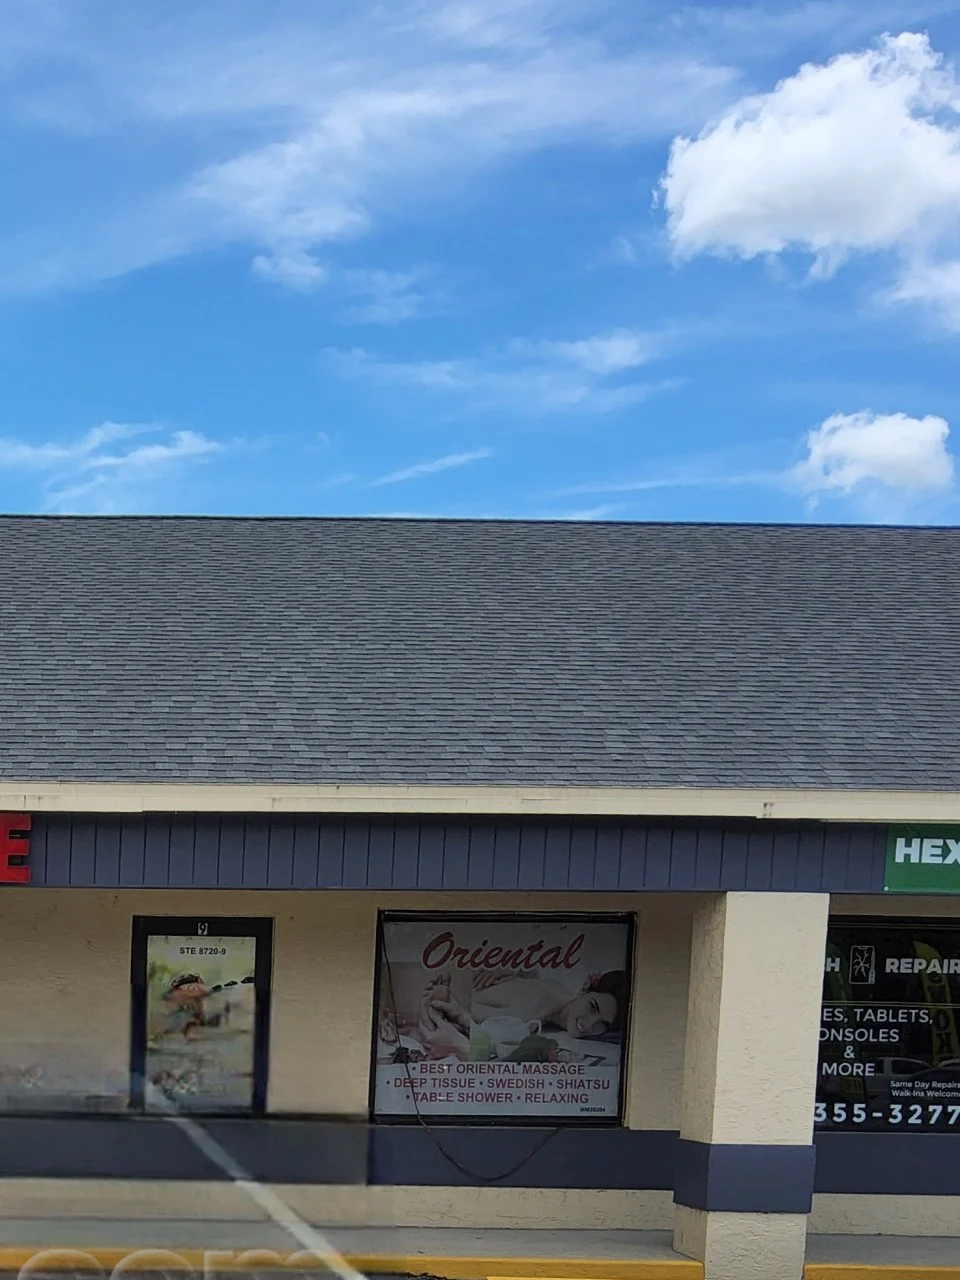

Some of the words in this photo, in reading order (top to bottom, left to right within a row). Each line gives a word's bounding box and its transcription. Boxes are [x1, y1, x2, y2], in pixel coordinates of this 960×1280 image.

[197, 922, 208, 936] 9
[179, 947, 197, 955] STE
[199, 947, 226, 955] 8720-9
[422, 931, 586, 970] Oriental
[853, 1008, 934, 1024] TABLETS,
[843, 1045, 856, 1059] &
[419, 1064, 453, 1074] BEST
[456, 1064, 519, 1075] ORIENTAL
[522, 1064, 586, 1075] MASSAGE
[822, 1063, 875, 1076] MORE
[393, 1077, 427, 1088] DEEP
[431, 1077, 475, 1088] TISSUE
[487, 1078, 545, 1089] SWEDISH
[556, 1078, 610, 1090] SHIATSU
[914, 1081, 930, 1089] Day
[413, 1092, 454, 1102] TABLE
[457, 1092, 513, 1103] SHOWER
[525, 1093, 589, 1104] RELAXING
